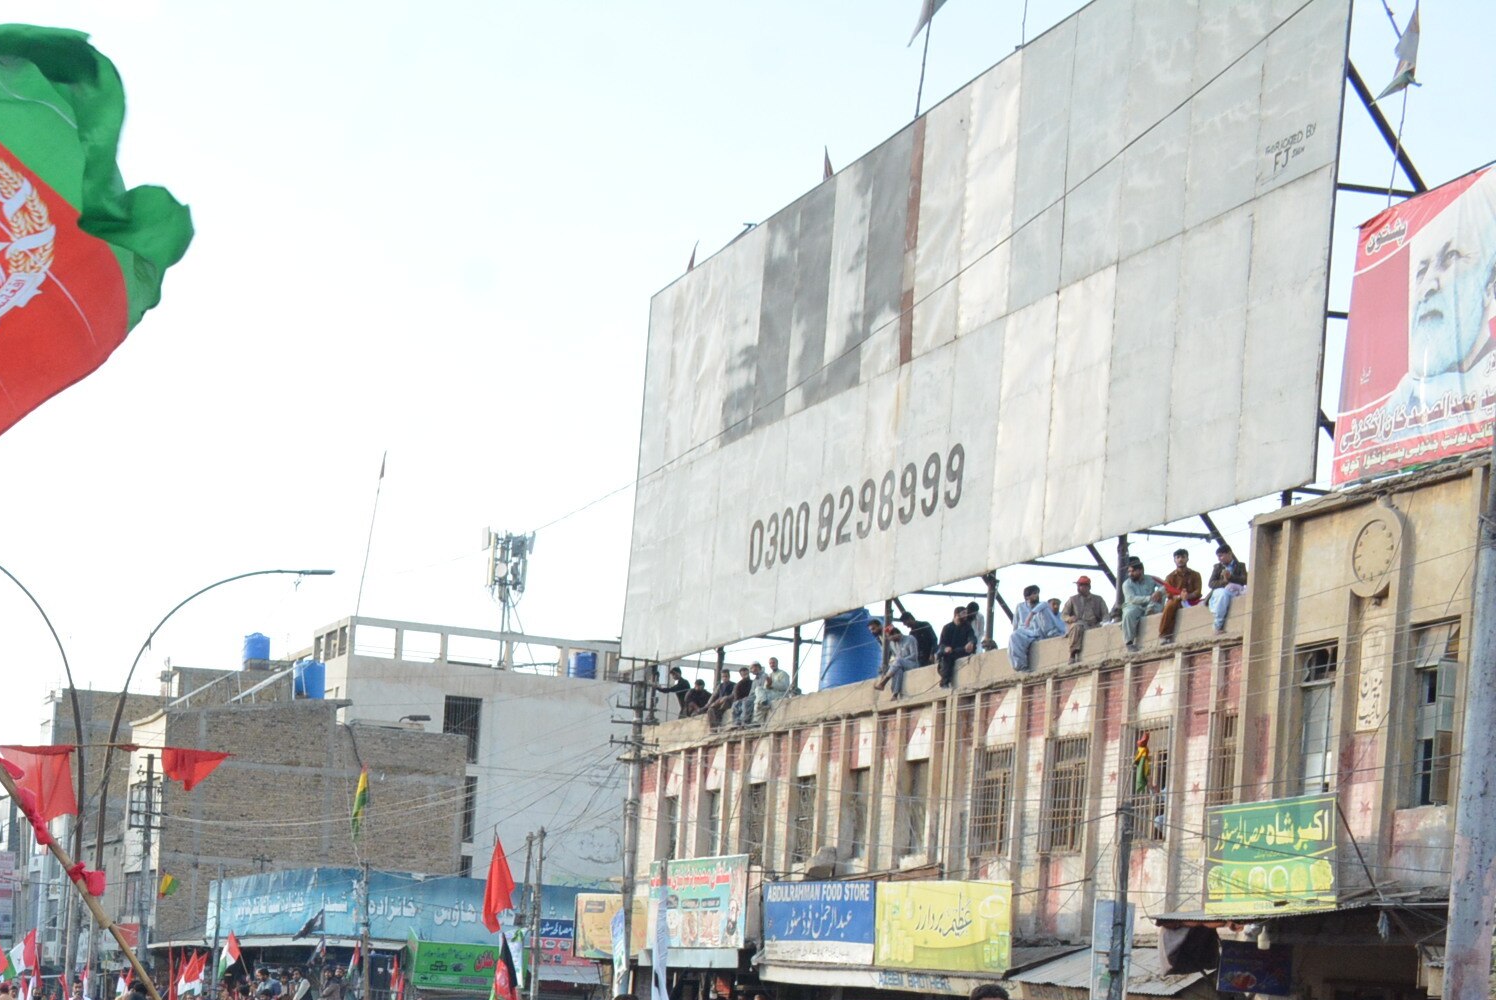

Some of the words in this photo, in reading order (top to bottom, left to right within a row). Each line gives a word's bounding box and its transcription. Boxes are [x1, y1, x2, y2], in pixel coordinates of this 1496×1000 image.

[749, 501, 811, 575] 0300
[766, 885, 821, 902] ABDULRAHMAN
[821, 884, 842, 901] FOOD
[844, 883, 870, 901] STORE
